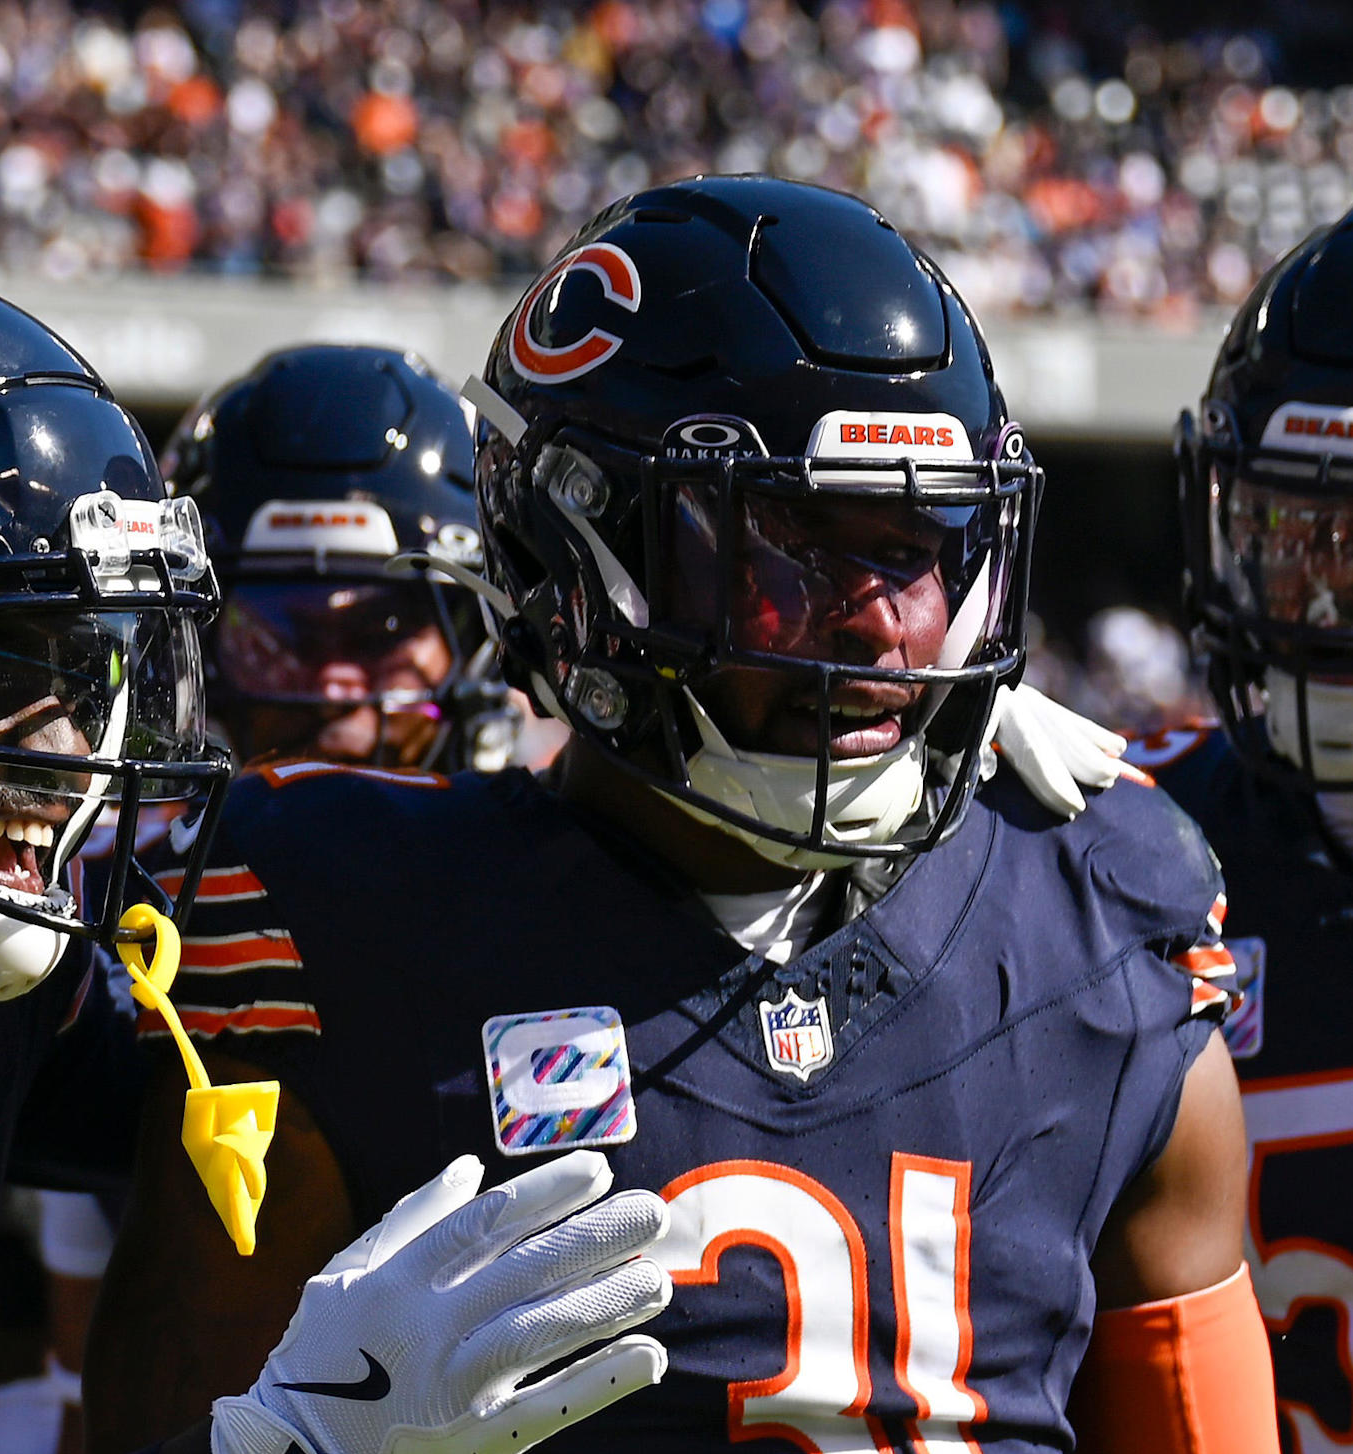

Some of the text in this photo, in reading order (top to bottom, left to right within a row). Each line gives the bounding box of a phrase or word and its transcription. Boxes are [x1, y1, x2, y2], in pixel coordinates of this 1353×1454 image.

[509, 242, 641, 384] C
[840, 424, 954, 446] BEARS
[497, 1017, 620, 1115] C
[775, 1031, 821, 1063] NFL
